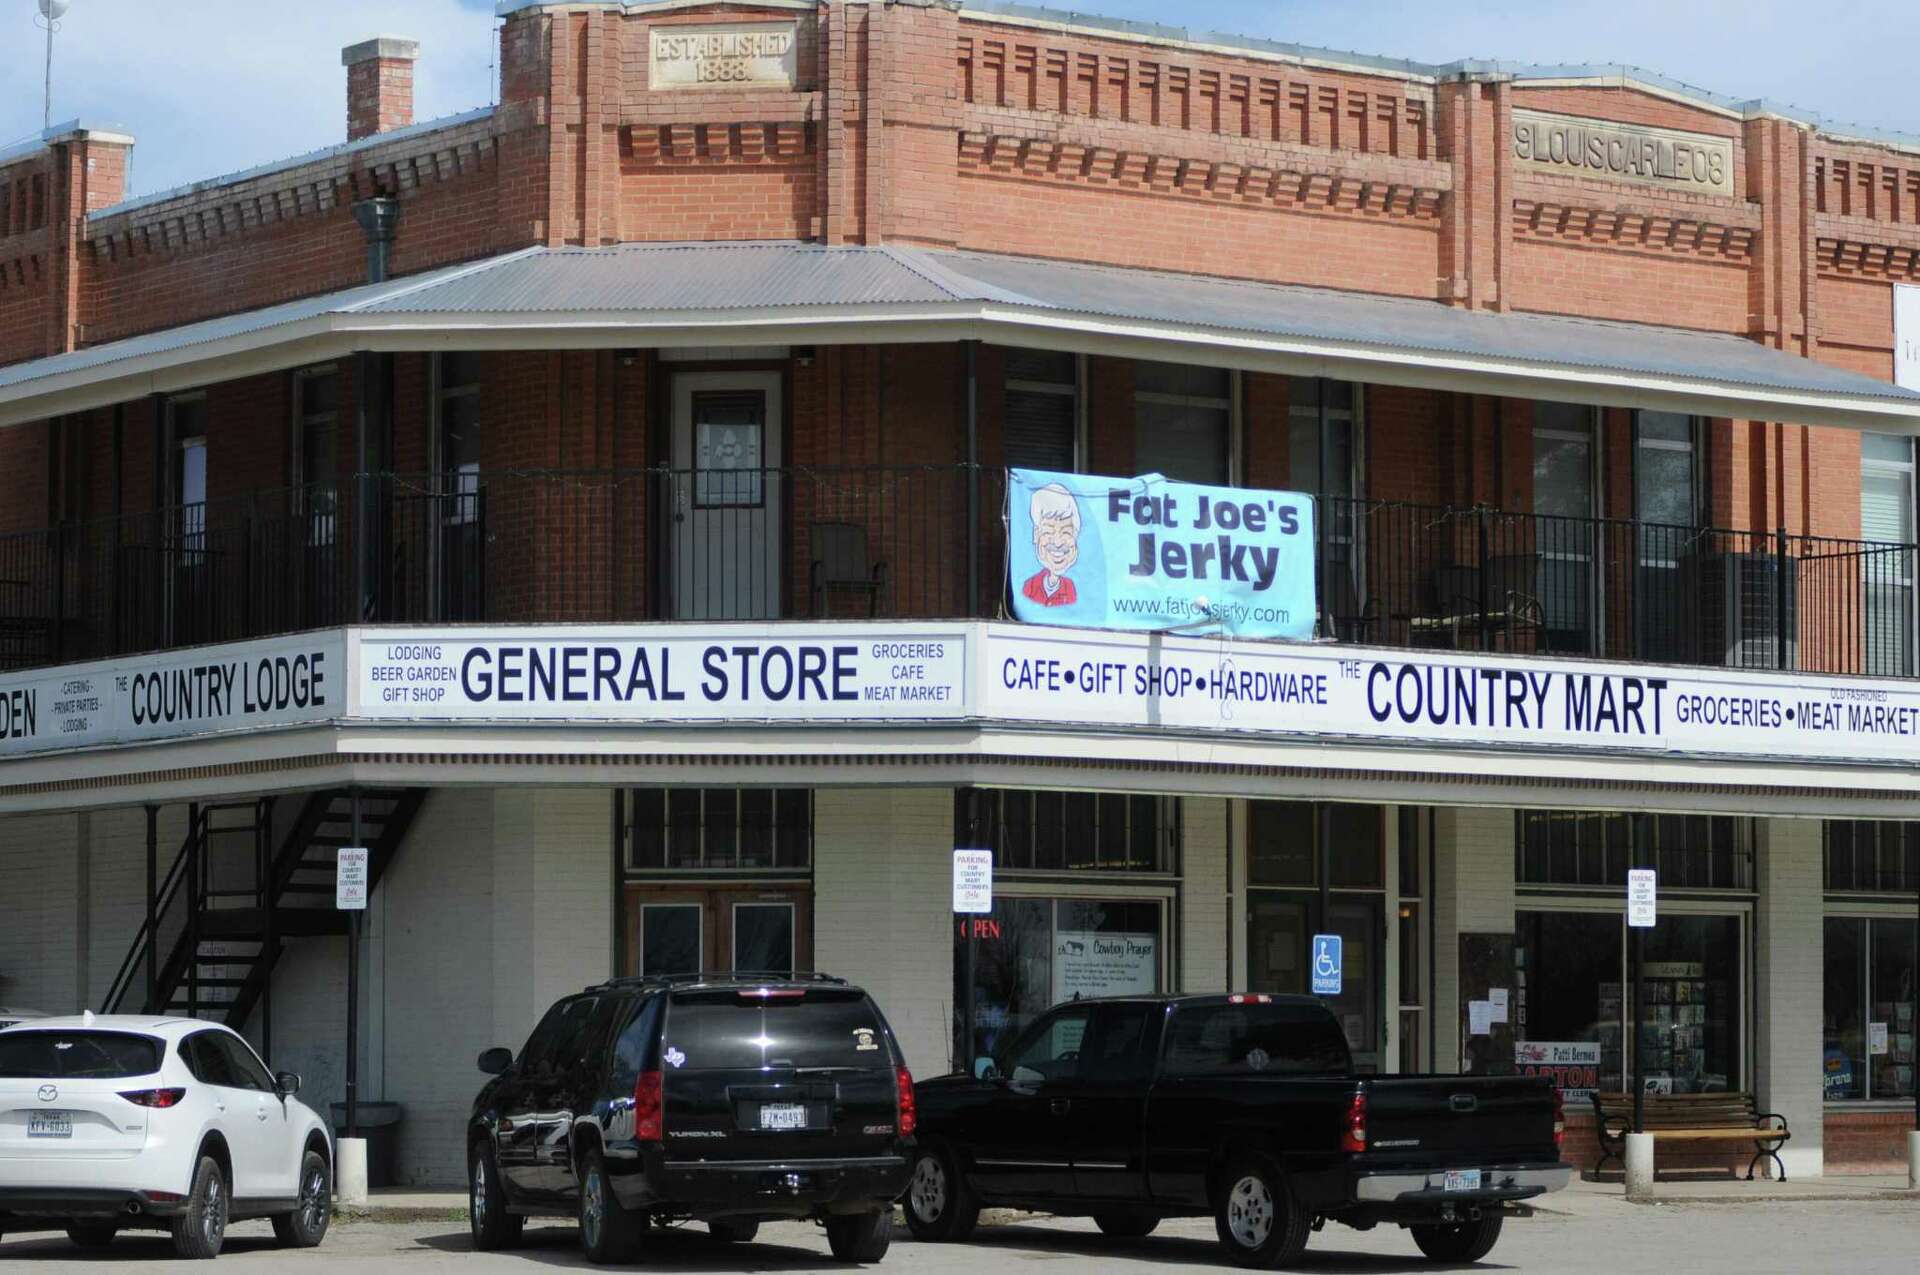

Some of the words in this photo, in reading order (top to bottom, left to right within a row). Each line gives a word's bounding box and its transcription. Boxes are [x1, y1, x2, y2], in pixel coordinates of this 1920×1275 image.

[655, 32, 789, 61] ESTABLISHED
[1533, 124, 1604, 169] LOUIS
[1606, 132, 1690, 182] CARLE
[1691, 144, 1724, 185] 08
[1108, 487, 1178, 528] Fat
[1193, 496, 1299, 535] Joe's
[1129, 532, 1280, 591] Jerky
[387, 645, 442, 660] LODGING
[872, 644, 944, 659] GROCERIES
[372, 666, 403, 682] BEER
[407, 666, 457, 682] GARDEN
[461, 647, 685, 702] GENERAL
[701, 645, 859, 702] STORE
[891, 665, 924, 680] CAFE
[1003, 656, 1060, 692] CAFE
[1079, 662, 1127, 696] GIFT
[1134, 664, 1192, 699] SHOP
[1210, 669, 1328, 705] HARDWARE
[115, 676, 128, 692] THE
[131, 661, 236, 725] COUNTRY
[243, 652, 325, 713] LODGE
[382, 687, 409, 702] GIFT
[412, 687, 445, 702] SHOP
[864, 686, 897, 702] MEAT
[900, 686, 952, 702] MARKET
[1339, 659, 1361, 679] THE
[1367, 662, 1552, 730] COUNTRY
[1565, 673, 1667, 735] MART
[1830, 687, 1845, 700] OLD
[1846, 688, 1888, 703] FASHIONED
[1676, 694, 1782, 729] GROCERIES
[1797, 701, 1842, 731] MEAT
[1848, 705, 1919, 736] MARKET
[957, 855, 989, 864] PARKING
[1093, 940, 1125, 958] Cowboy
[1126, 940, 1152, 958] Prayer
